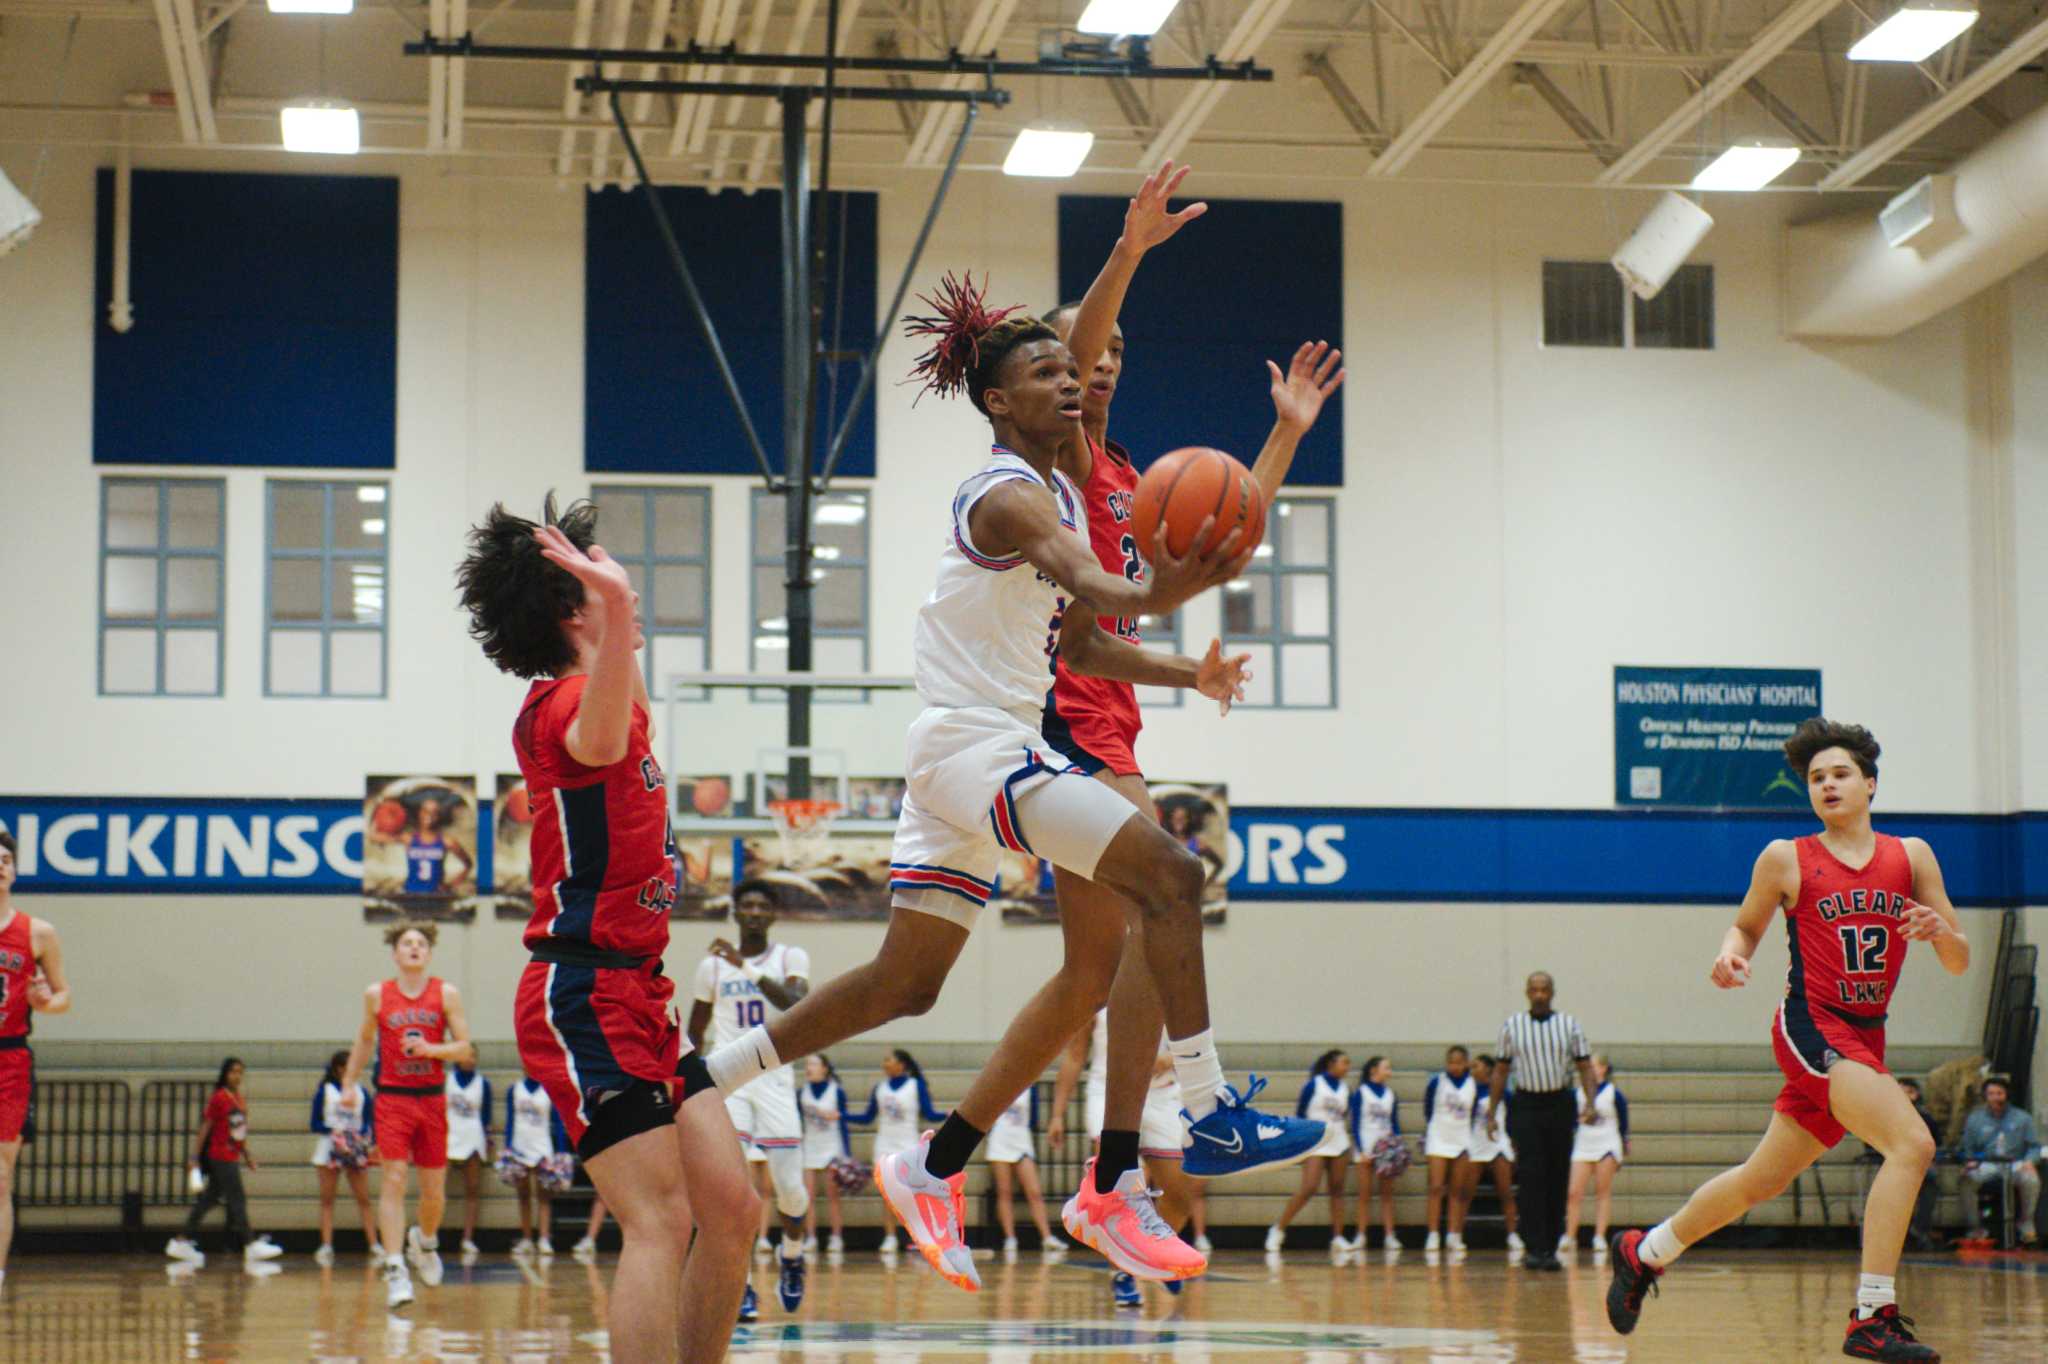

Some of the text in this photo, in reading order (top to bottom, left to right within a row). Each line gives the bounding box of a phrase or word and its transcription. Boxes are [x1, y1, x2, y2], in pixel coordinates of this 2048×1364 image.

[1117, 615, 1141, 640] LA
[1618, 682, 1679, 704] HOUSTON
[1760, 685, 1818, 707] HOSPITAL
[0, 812, 364, 878] ICKINSO
[1817, 889, 1905, 922] CLEAR
[1837, 924, 1889, 974] 12
[1836, 980, 1888, 1004] LAKE
[736, 1000, 765, 1029] 10
